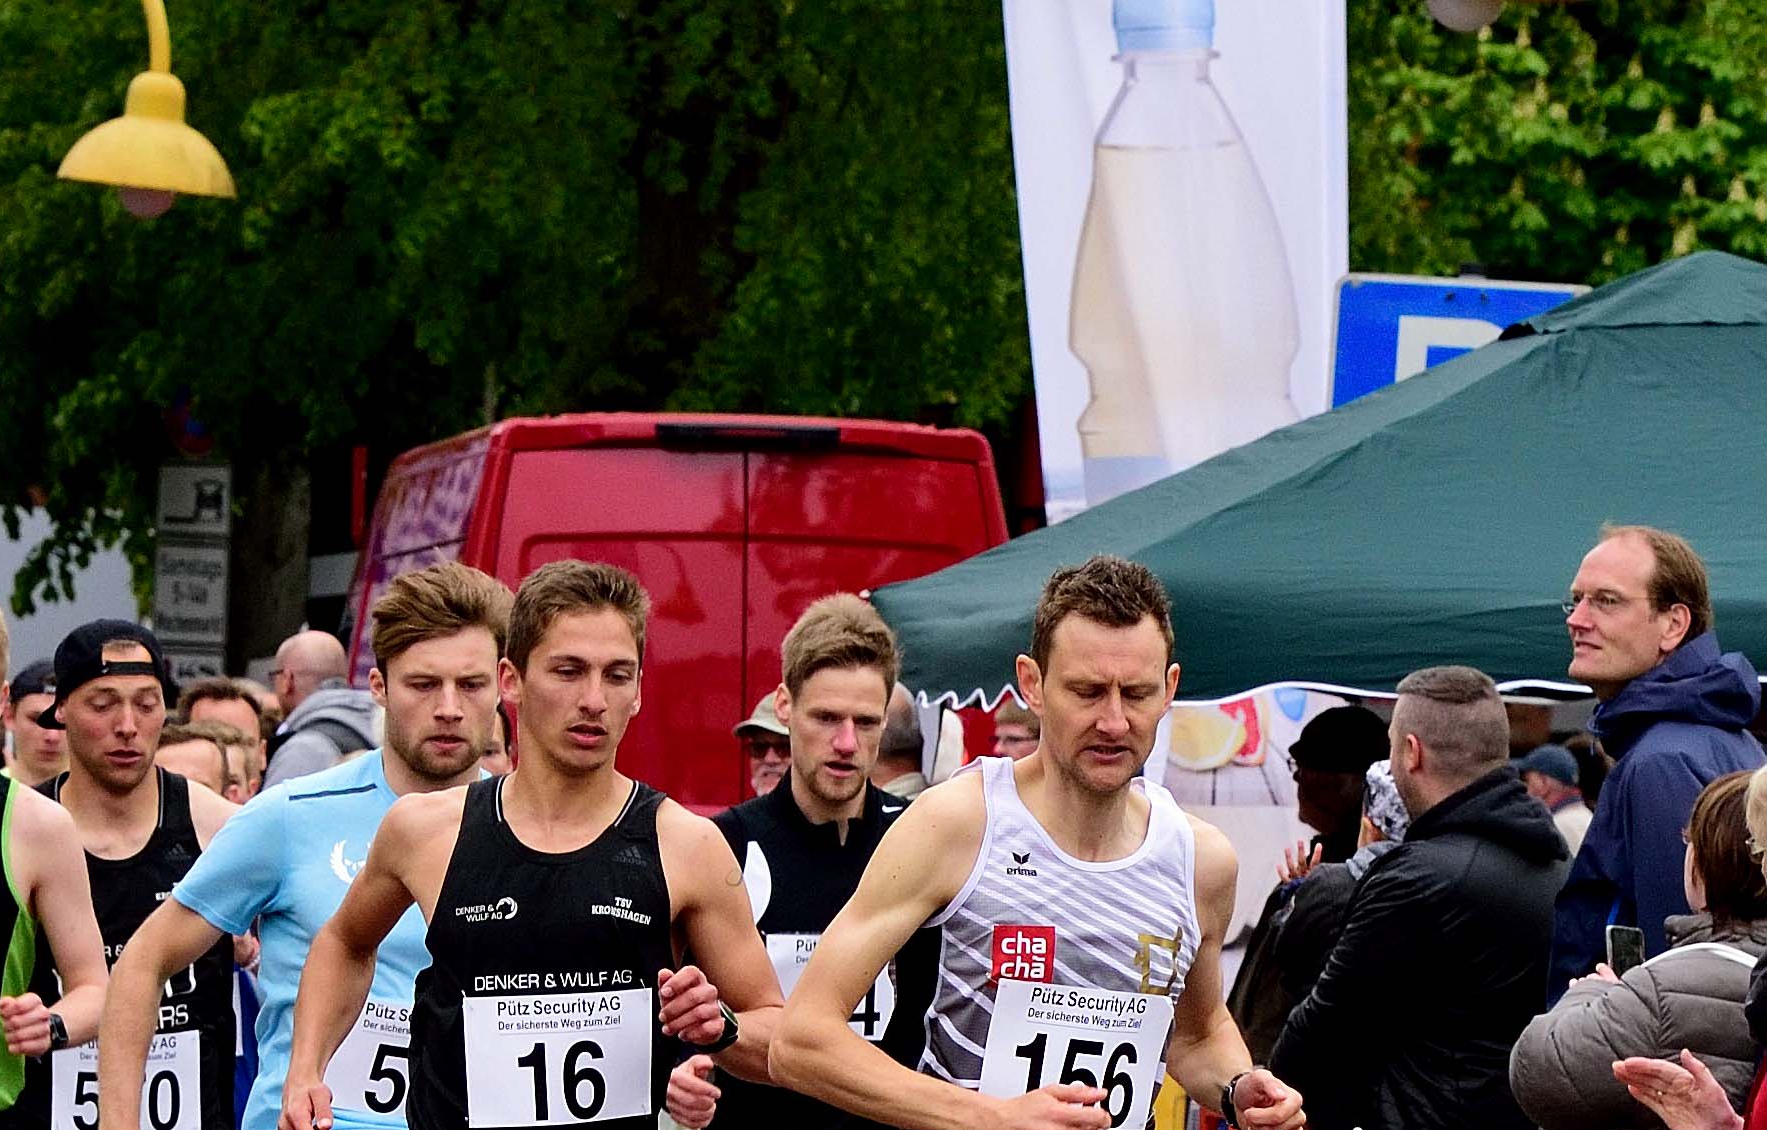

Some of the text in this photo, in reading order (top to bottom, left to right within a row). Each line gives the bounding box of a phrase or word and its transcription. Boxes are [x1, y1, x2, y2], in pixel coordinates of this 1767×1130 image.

[1006, 867, 1037, 877] erima
[455, 903, 495, 916] DENKER &
[614, 896, 633, 909] TSV
[466, 912, 503, 923] WULF AG
[591, 904, 652, 925] KRONSHAGEN
[1000, 931, 1047, 955] cha
[474, 969, 633, 992] DENKER & WULF AG
[365, 1002, 397, 1020] Pütz
[497, 995, 622, 1017] Pütz Security AG
[1031, 987, 1148, 1017] Pütz Security AG
[363, 1019, 410, 1036] Der sichers
[498, 1015, 621, 1031] Der sicherste Weg zum Ziel
[1027, 1008, 1143, 1030] Der sicherste Weg zum Ziel
[160, 1035, 177, 1049] AG
[364, 1043, 410, 1114] 5
[517, 1040, 607, 1122] 16
[1015, 1032, 1138, 1129] 156
